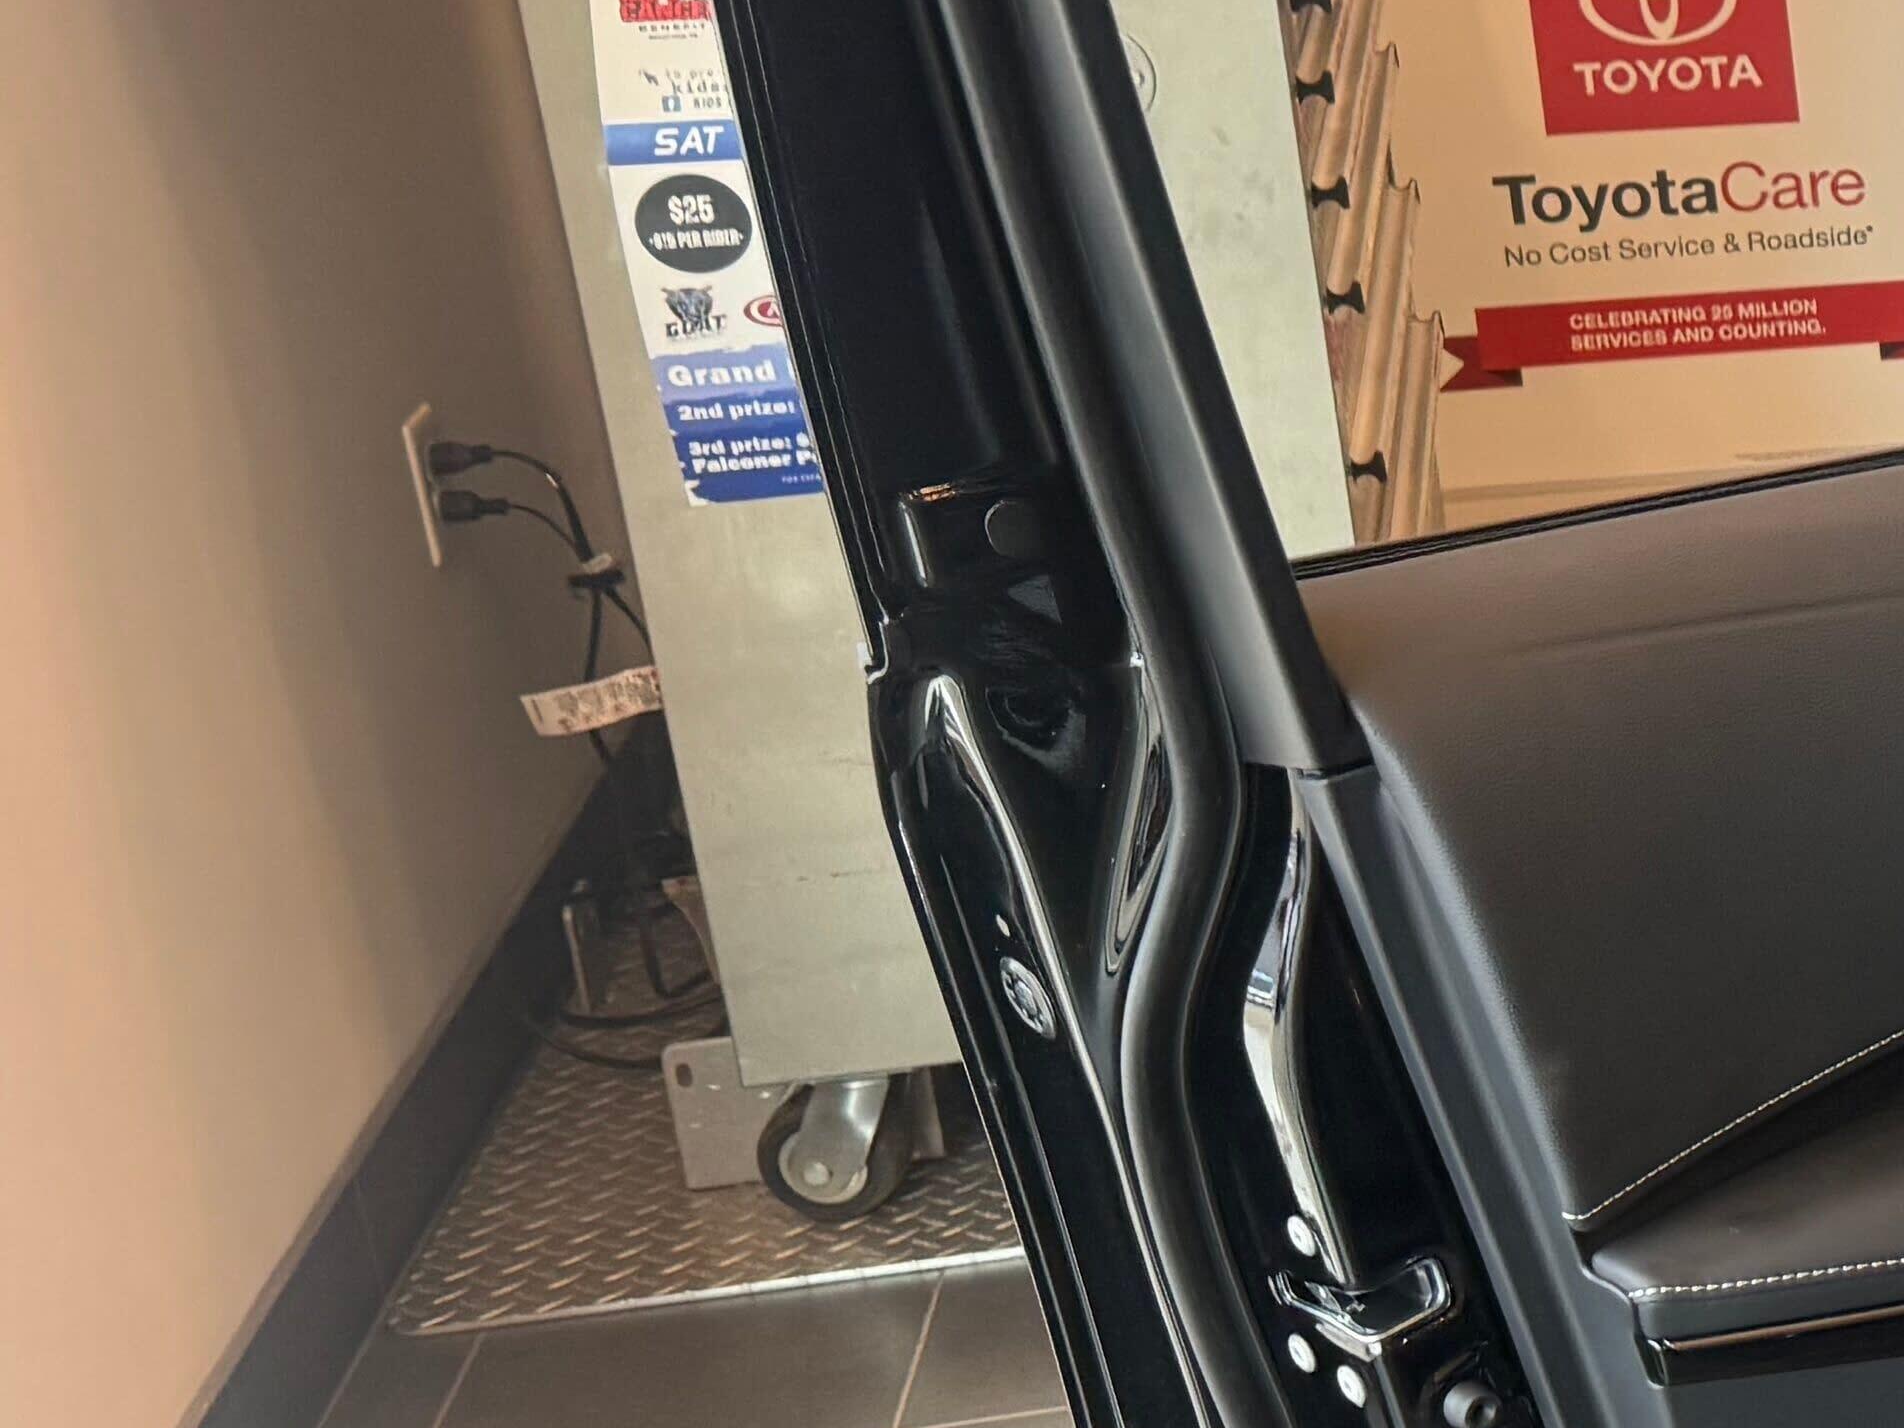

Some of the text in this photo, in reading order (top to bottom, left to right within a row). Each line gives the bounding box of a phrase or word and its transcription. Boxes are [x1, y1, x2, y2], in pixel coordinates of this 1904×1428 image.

[1572, 54, 1763, 96] TOYOTA
[653, 126, 724, 156] SAT
[667, 194, 715, 226] $25
[1491, 160, 1866, 233] ToyotaCare
[1505, 244, 1542, 268] No
[1549, 240, 1611, 265] Cost
[1619, 234, 1716, 261] Service
[1723, 232, 1741, 253] &
[1569, 305, 1706, 331] CELEBRATING
[1738, 299, 1818, 320] MILLION
[1571, 328, 1667, 352] SERVICES
[1672, 325, 1714, 344] AND
[667, 358, 777, 387] Grand
[677, 399, 796, 421] 2nd prize:
[688, 439, 726, 456] 3rd
[730, 436, 793, 456] prize:
[691, 453, 792, 474] Falconer
